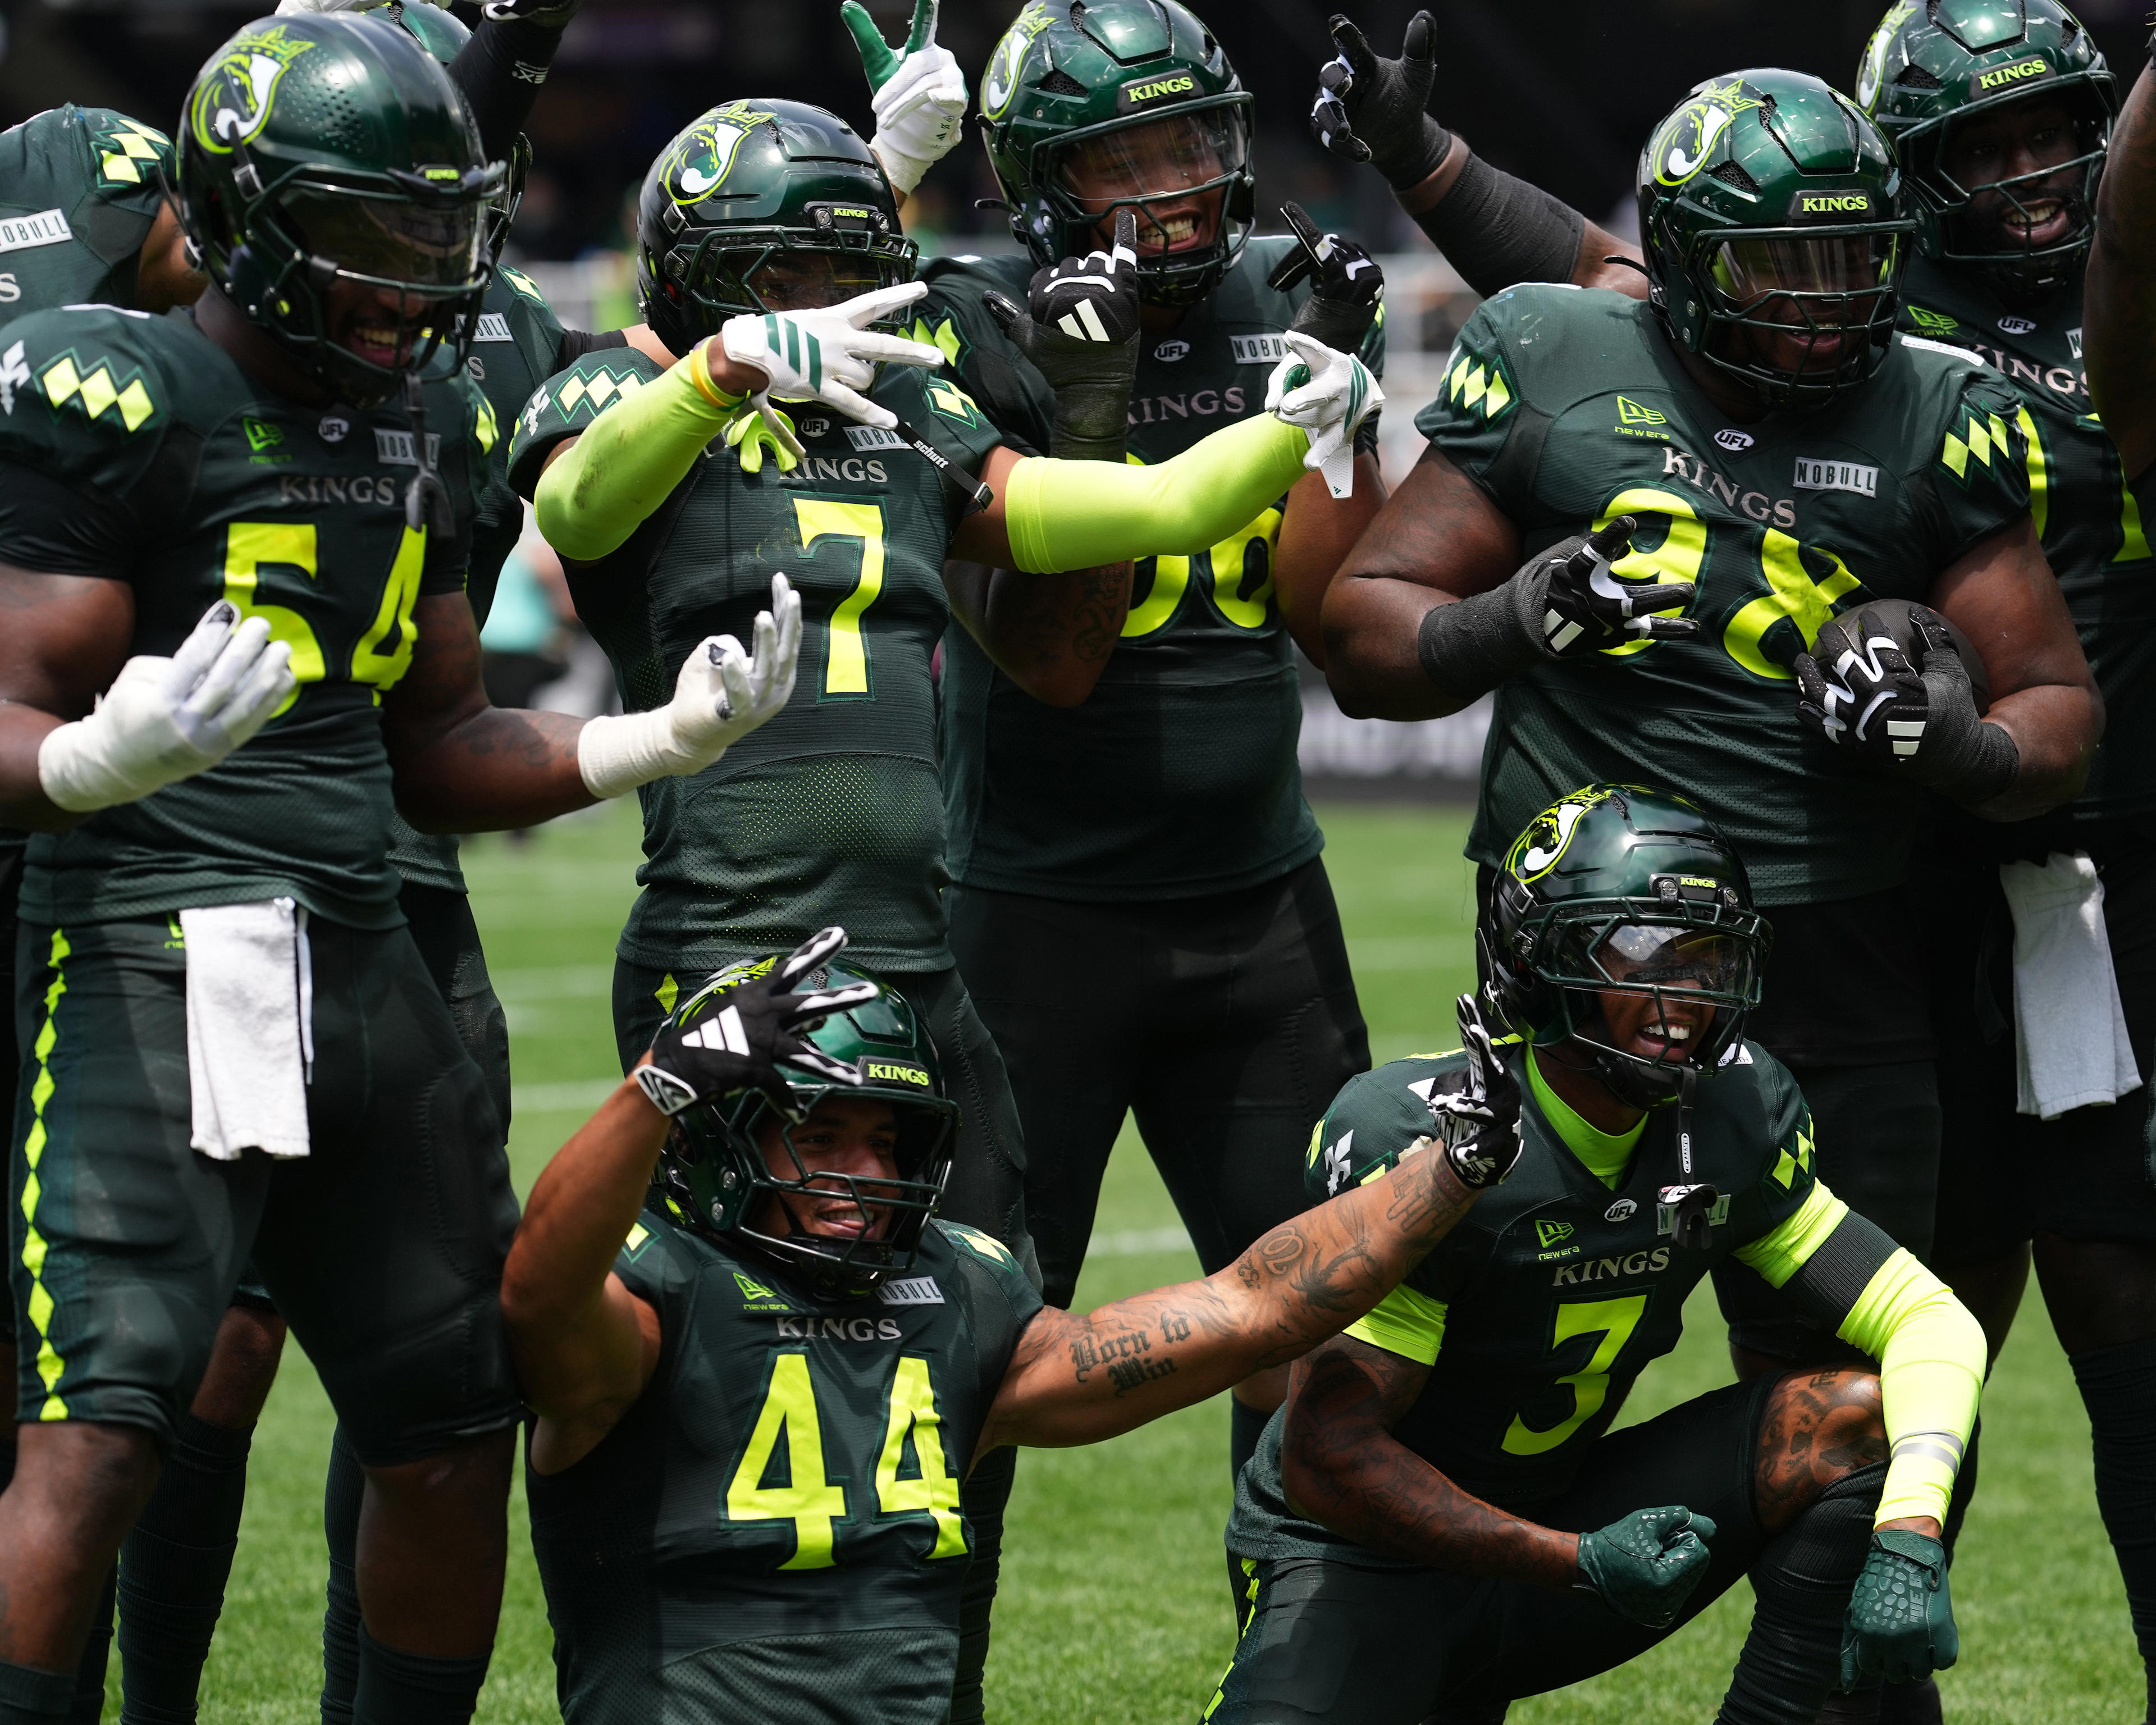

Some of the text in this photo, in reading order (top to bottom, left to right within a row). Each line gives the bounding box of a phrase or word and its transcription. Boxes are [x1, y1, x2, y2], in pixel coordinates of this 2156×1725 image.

[1979, 59, 2047, 90] KINGS
[1127, 76, 1194, 103] KINGS
[833, 208, 869, 218] KINGS
[1802, 196, 1869, 212] KINGS
[0, 216, 68, 246] OBULL
[2001, 318, 2034, 331] UFL
[1157, 345, 1189, 358] UFL
[1232, 339, 1289, 359] NOBU
[1961, 343, 2090, 396] ING
[322, 420, 348, 436] UFL
[803, 421, 829, 434] UFL
[847, 430, 907, 448] NOBU
[1718, 431, 1750, 448] UFL
[378, 436, 436, 463] NOBL
[912, 440, 952, 469] schutt
[1662, 447, 1796, 528] KINGS
[1797, 462, 1874, 491] NOBULL
[281, 476, 395, 505] KINGS
[792, 498, 884, 693] 7
[223, 523, 426, 719] 54
[1680, 877, 1717, 888] KINGS
[867, 1064, 929, 1086] KINGS
[1608, 1206, 1634, 1220] UFL
[1551, 1247, 1670, 1286] KINGS
[775, 1316, 902, 1342] KINGS
[1069, 1312, 1191, 1382] Born to
[1107, 1357, 1177, 1398] Win
[1501, 1294, 1647, 1455] 3
[727, 1354, 969, 1570] 44
